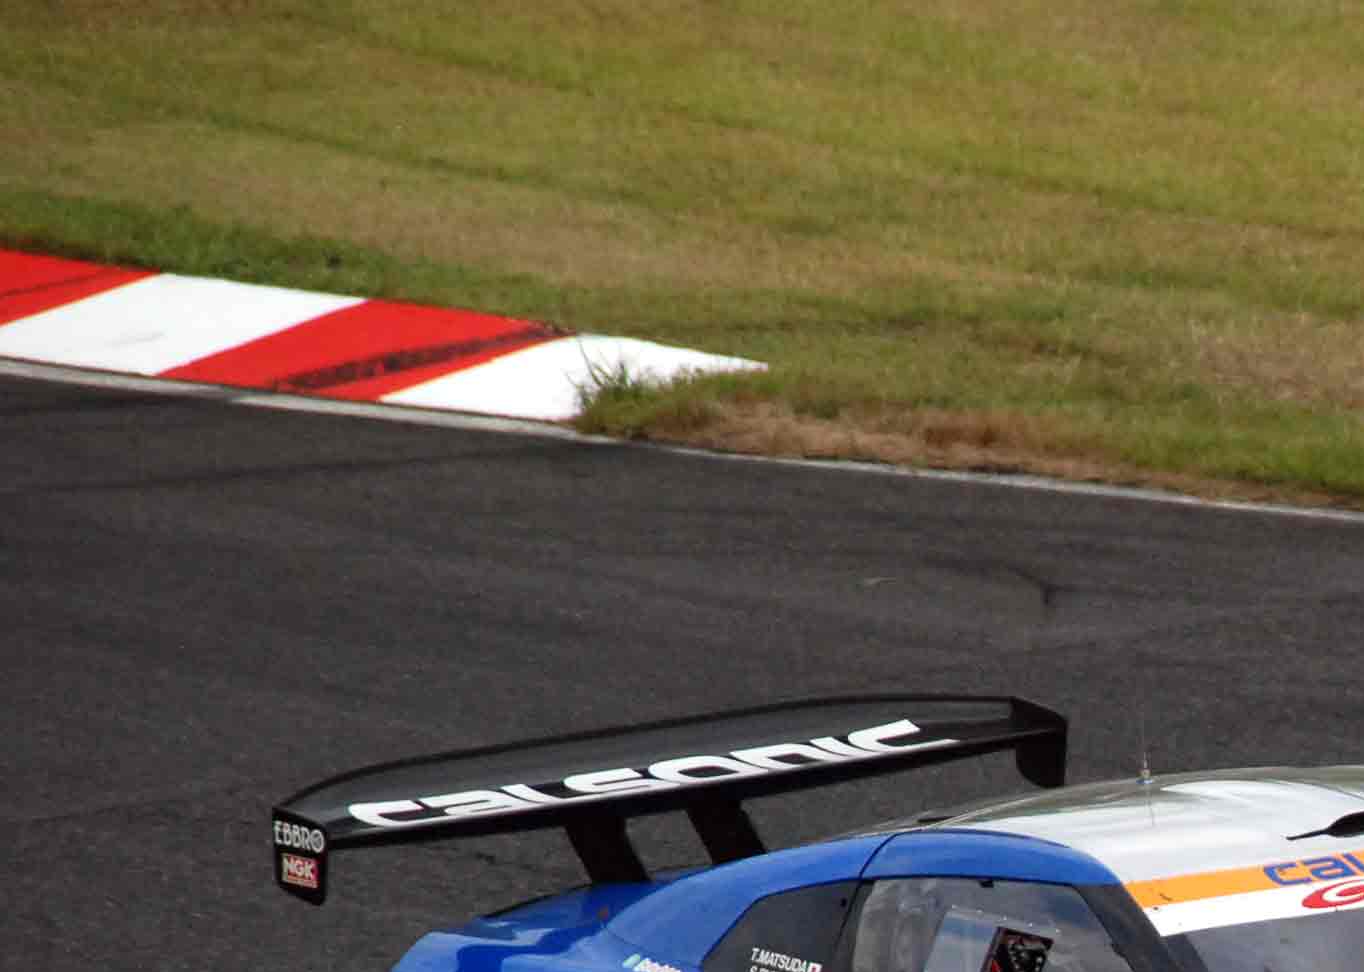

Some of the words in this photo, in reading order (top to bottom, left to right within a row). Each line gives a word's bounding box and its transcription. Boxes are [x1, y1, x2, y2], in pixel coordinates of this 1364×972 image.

[347, 719, 959, 828] CALSONIC
[274, 820, 325, 854] EBBRO
[751, 948, 807, 972] T.MATSUDA
